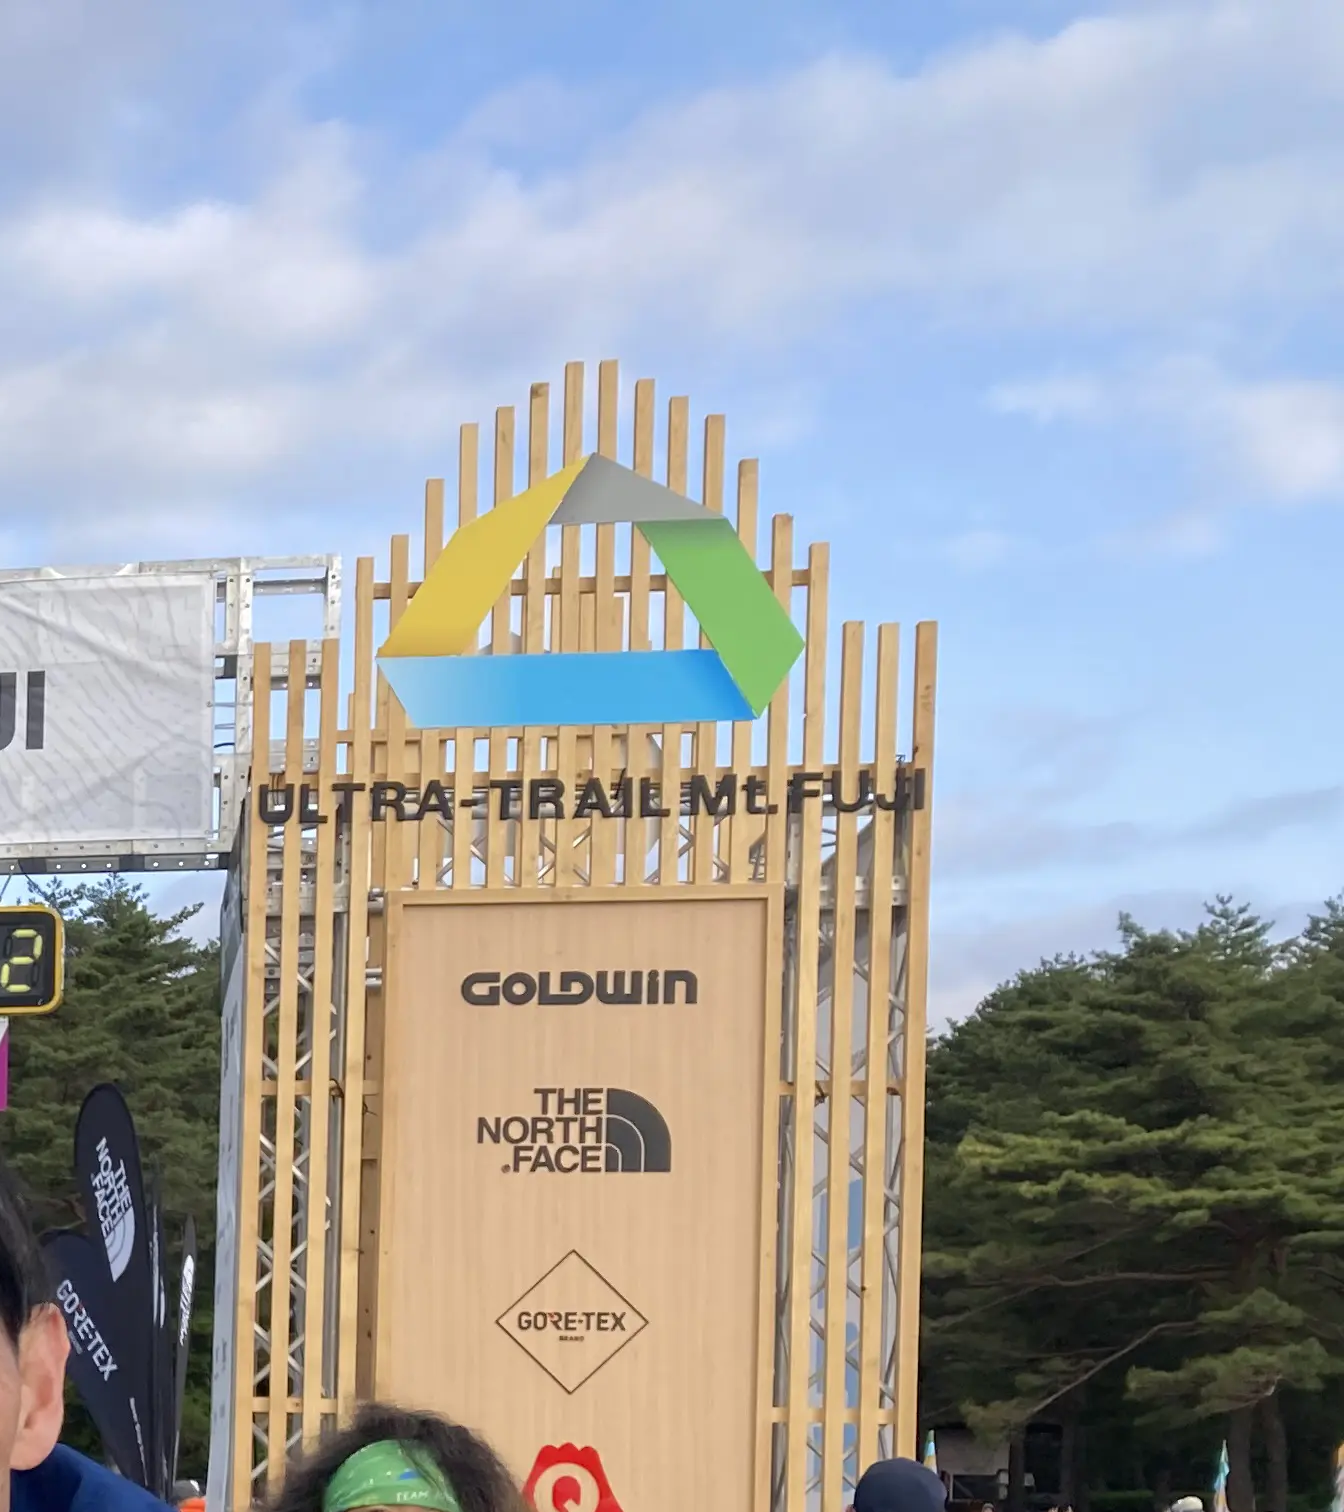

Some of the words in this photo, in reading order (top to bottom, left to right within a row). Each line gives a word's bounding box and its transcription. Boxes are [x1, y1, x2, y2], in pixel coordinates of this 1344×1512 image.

[259, 777, 670, 823] ULTRA-TRAIL
[690, 768, 925, 815] Mt.FUJI
[534, 1087, 603, 1115] THE
[477, 1117, 603, 1144] NORTH
[512, 1145, 603, 1173] FACE
[95, 1136, 122, 1227] NORTH
[118, 1158, 132, 1215] THE
[91, 1172, 114, 1239] FACE
[517, 1310, 627, 1332] GORE-TEX
